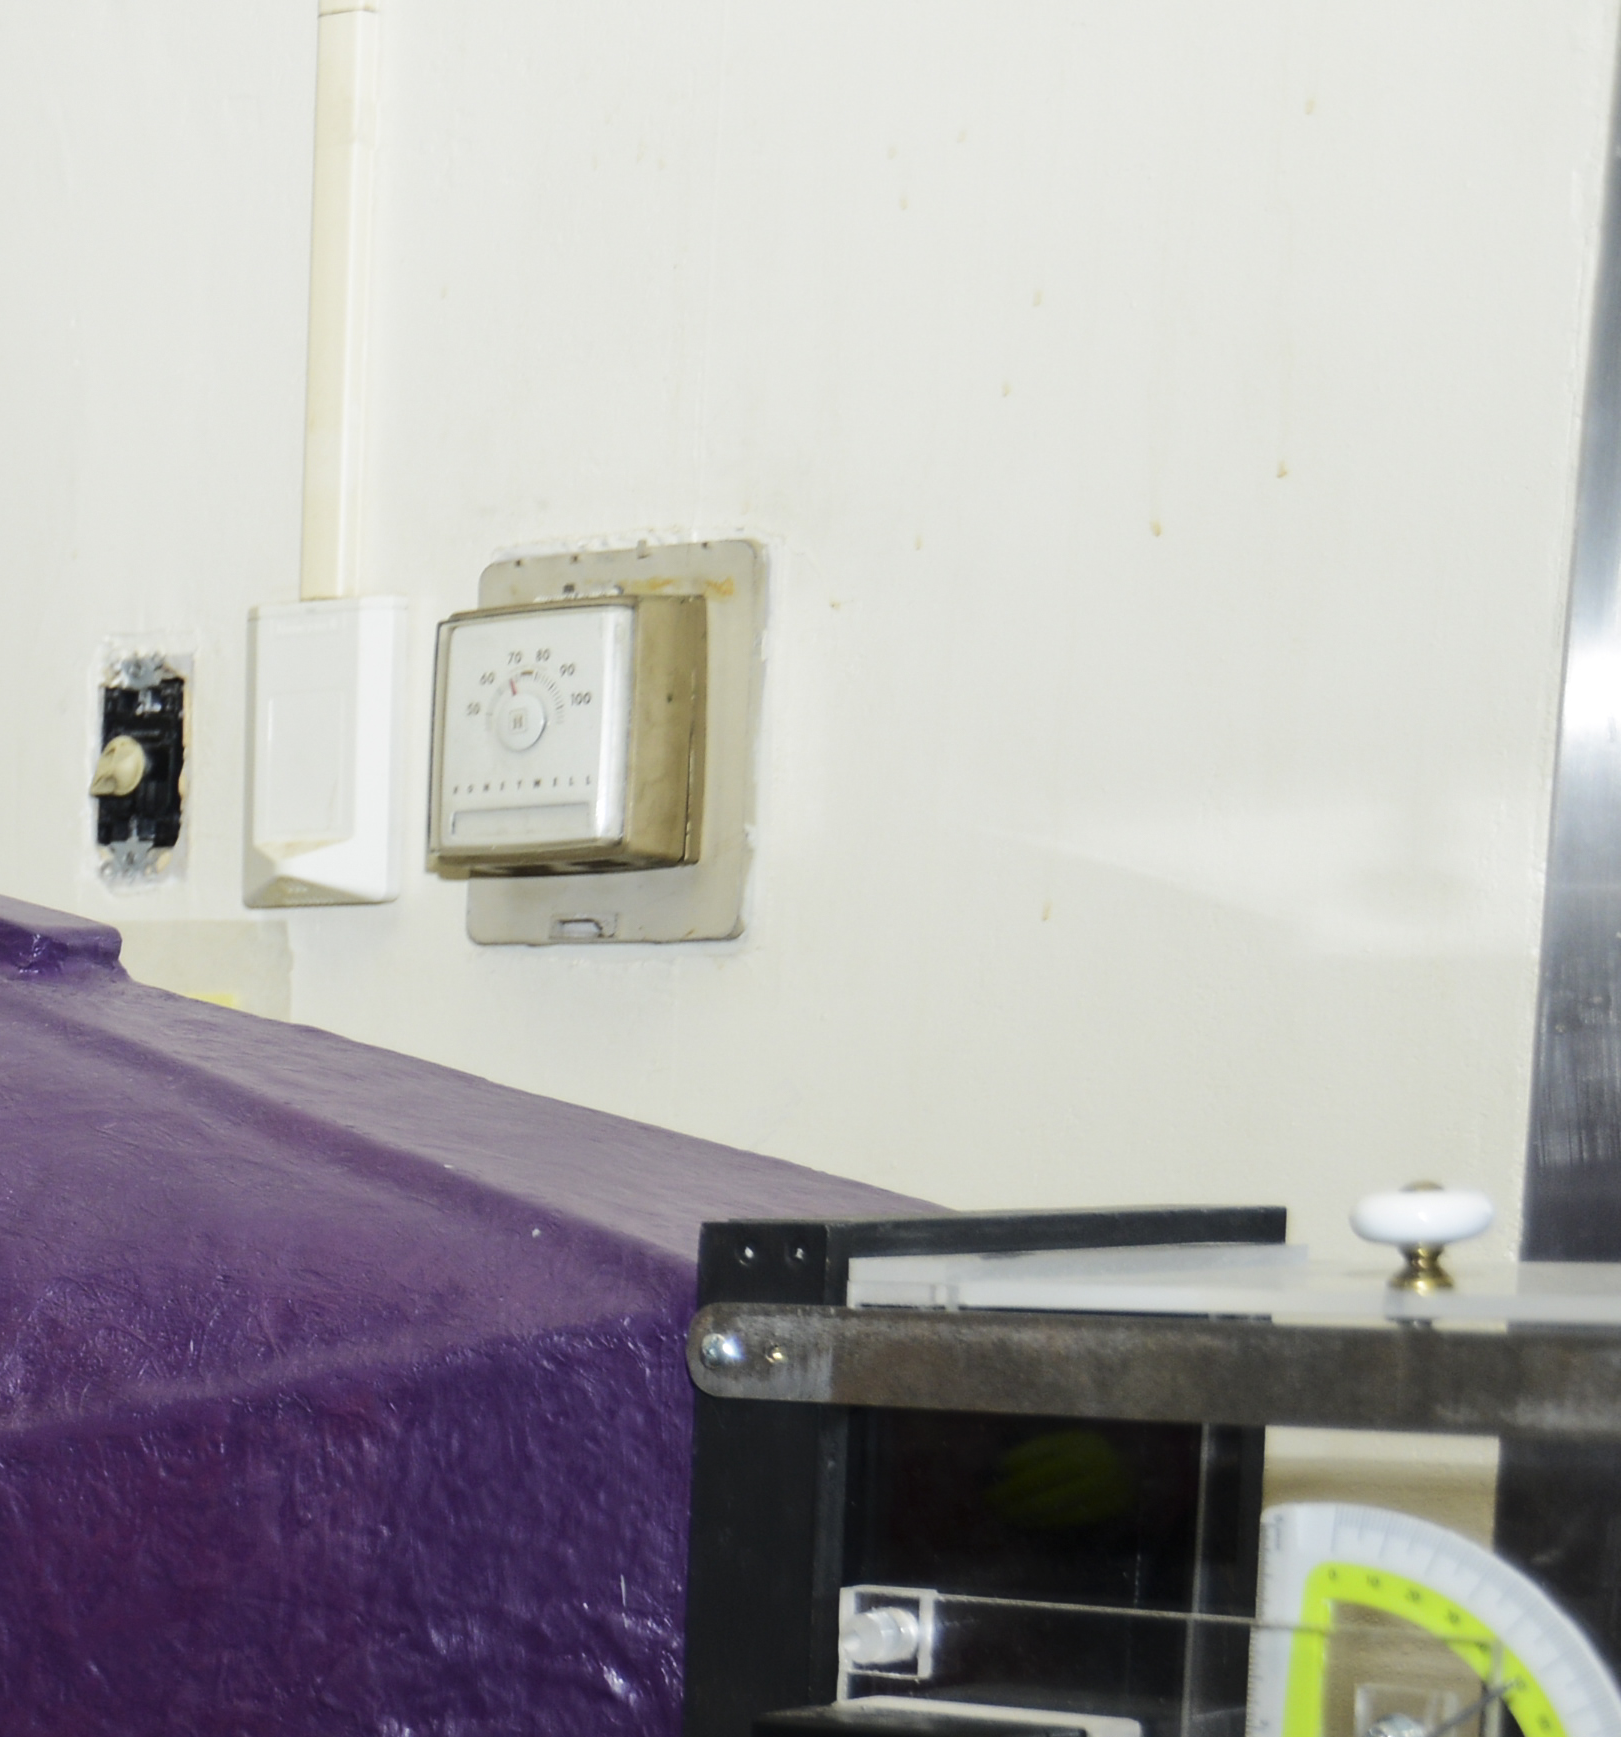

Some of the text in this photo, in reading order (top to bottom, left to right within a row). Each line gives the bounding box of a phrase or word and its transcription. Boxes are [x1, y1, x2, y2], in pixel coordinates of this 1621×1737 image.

[507, 650, 523, 665] 70
[535, 648, 551, 662] 80
[559, 662, 576, 677] 90
[570, 691, 592, 706] 100
